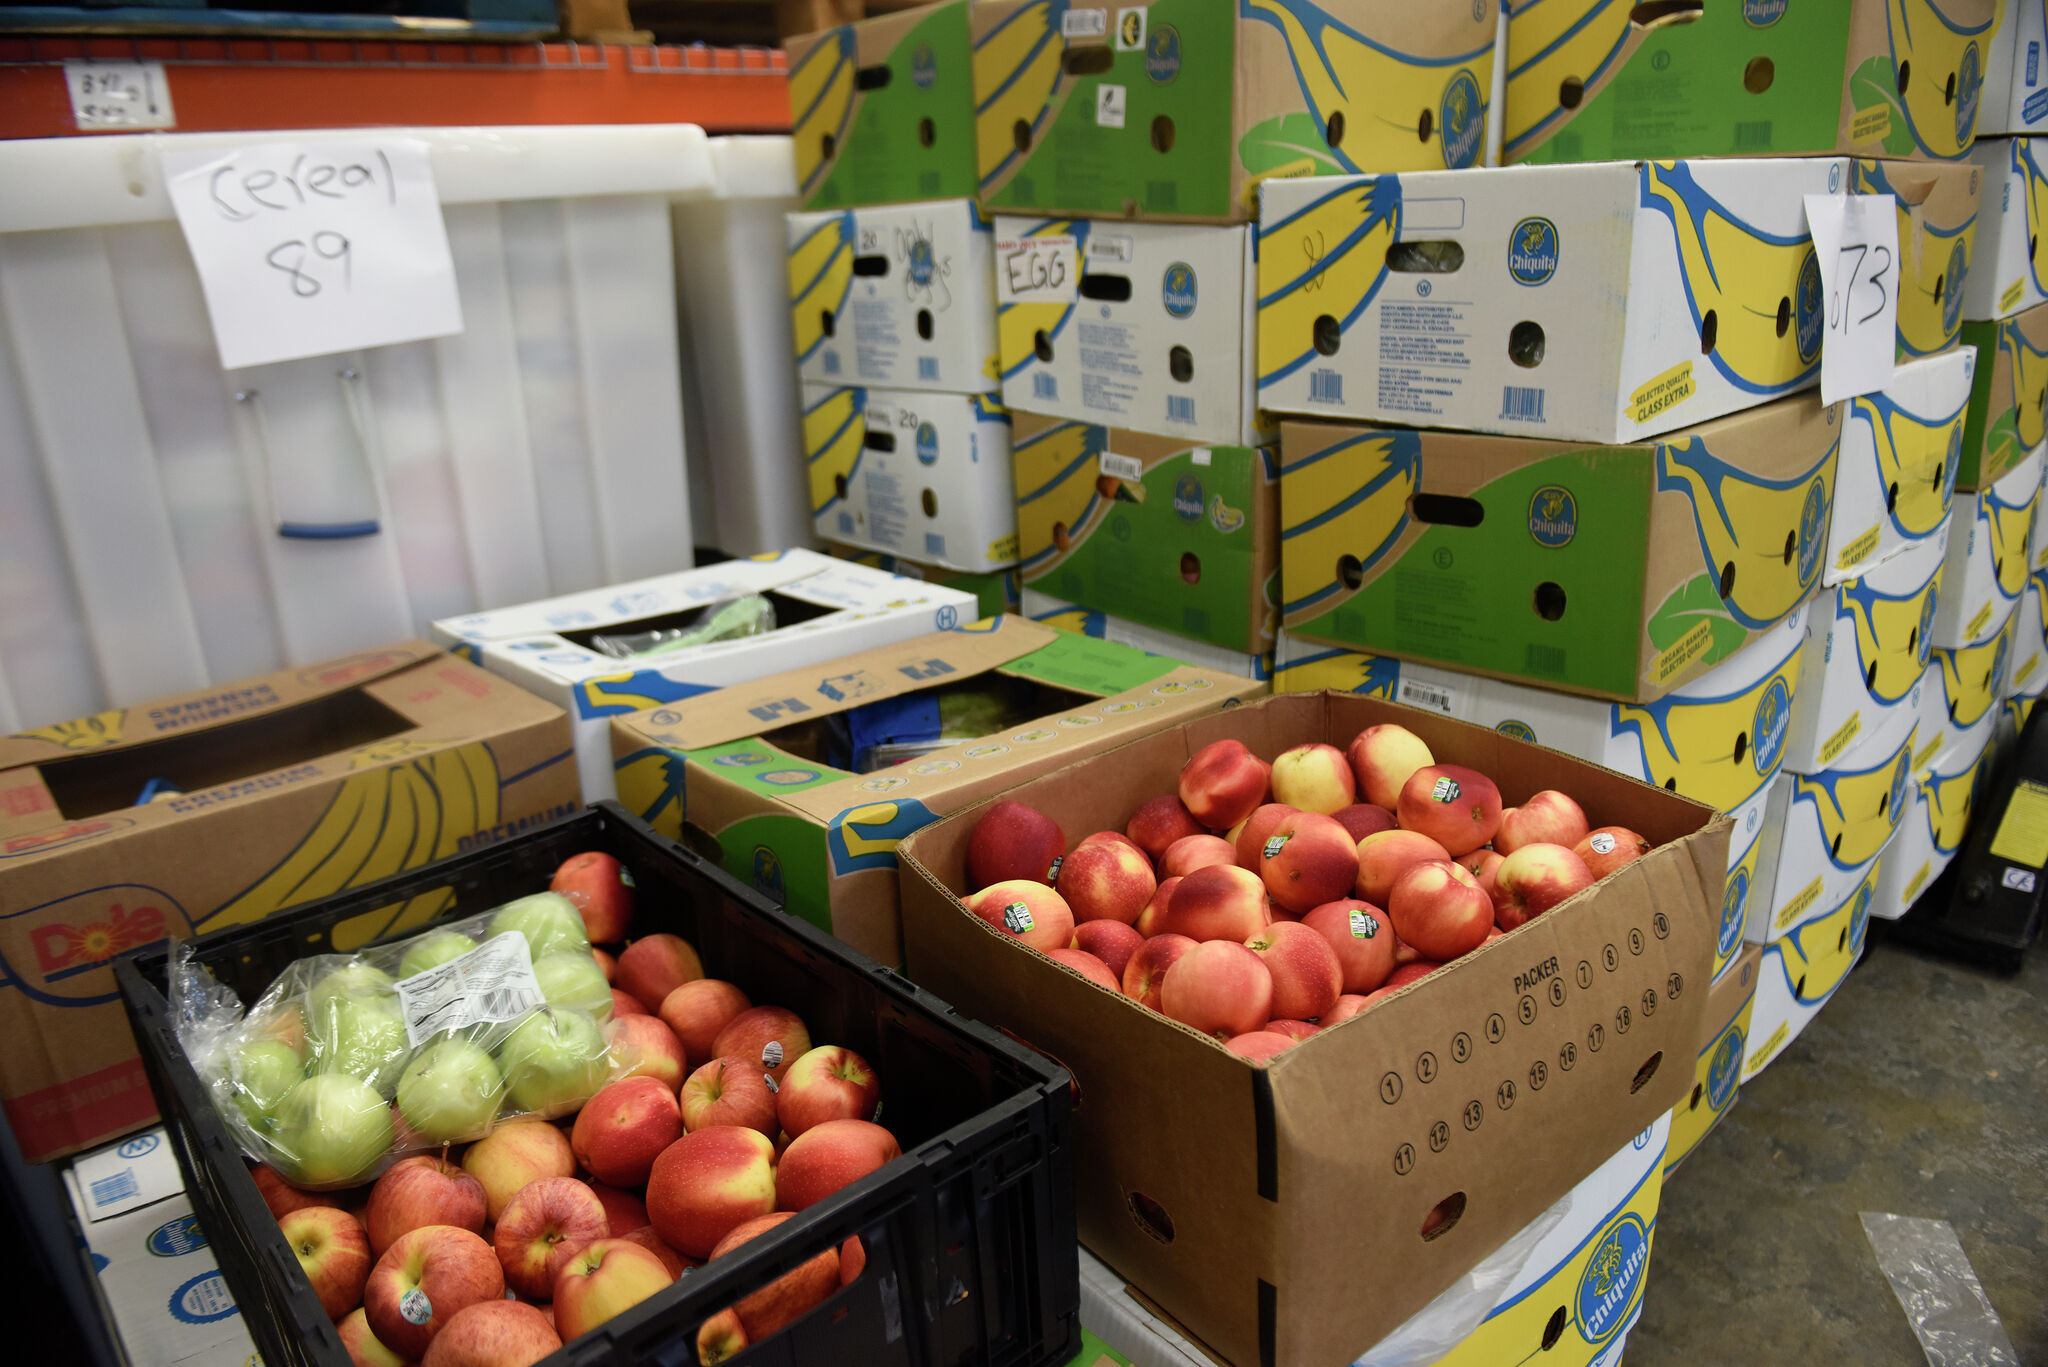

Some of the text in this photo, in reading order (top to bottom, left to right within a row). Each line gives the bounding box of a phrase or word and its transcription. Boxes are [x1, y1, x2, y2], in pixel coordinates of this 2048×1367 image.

[210, 150, 396, 220] Cereal
[266, 230, 351, 297] 89
[1006, 247, 1066, 295] EGG
[1510, 254, 1556, 274] Chiquita
[1636, 368, 1691, 407] SELECTED QUALITY
[1638, 383, 1690, 422] CLASS EXTRA
[1529, 517, 1576, 537] Chiquita
[1660, 624, 1707, 668] ORGANIC BANANA
[1660, 634, 1709, 680] SELECTED QUALITY
[1755, 706, 1790, 771] Chiquita
[29, 903, 166, 973] Dole
[1514, 956, 1560, 995] PACKER
[1585, 1239, 1647, 1341] Chiquita
